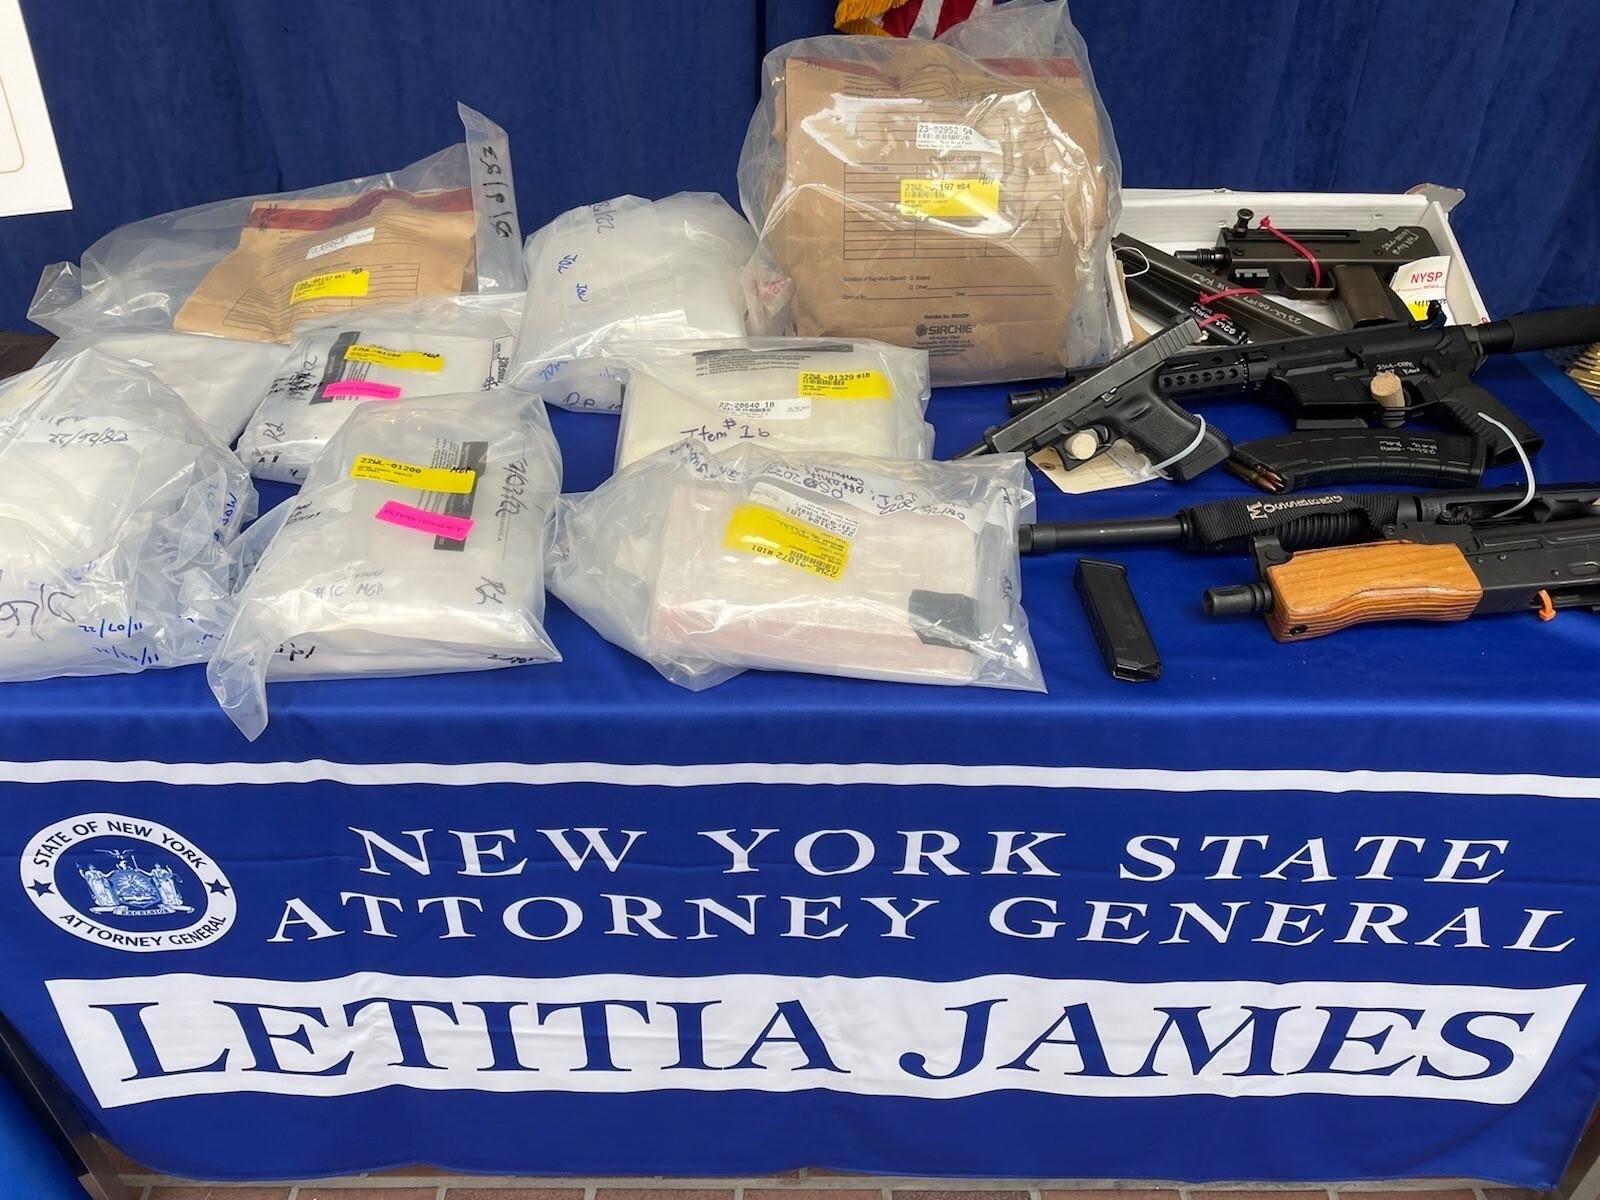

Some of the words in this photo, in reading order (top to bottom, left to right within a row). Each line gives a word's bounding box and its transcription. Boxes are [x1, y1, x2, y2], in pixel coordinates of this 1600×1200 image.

[1410, 271, 1443, 284] NYSP
[928, 324, 973, 335] SIRCHIE
[802, 373, 854, 381] 22WL-01329
[360, 456, 422, 474] 22WL-01200
[384, 508, 416, 522] RETURN
[428, 521, 463, 532] AGENCY
[78, 616, 143, 638] 11/07/22
[34, 831, 72, 868] STATE
[72, 821, 98, 836] OF
[106, 820, 153, 838] NEW
[161, 833, 208, 868] YORK
[349, 827, 647, 876] NEW
[697, 829, 1066, 876] YORK
[1120, 835, 1509, 883] STATE
[60, 913, 162, 947] ATTORNEY
[168, 914, 227, 946] GENERAL
[267, 892, 939, 943] ATTORNEY
[989, 897, 1575, 952] GENERAL
[90, 998, 850, 1077] LETITIA
[900, 999, 1534, 1081] JAMES
